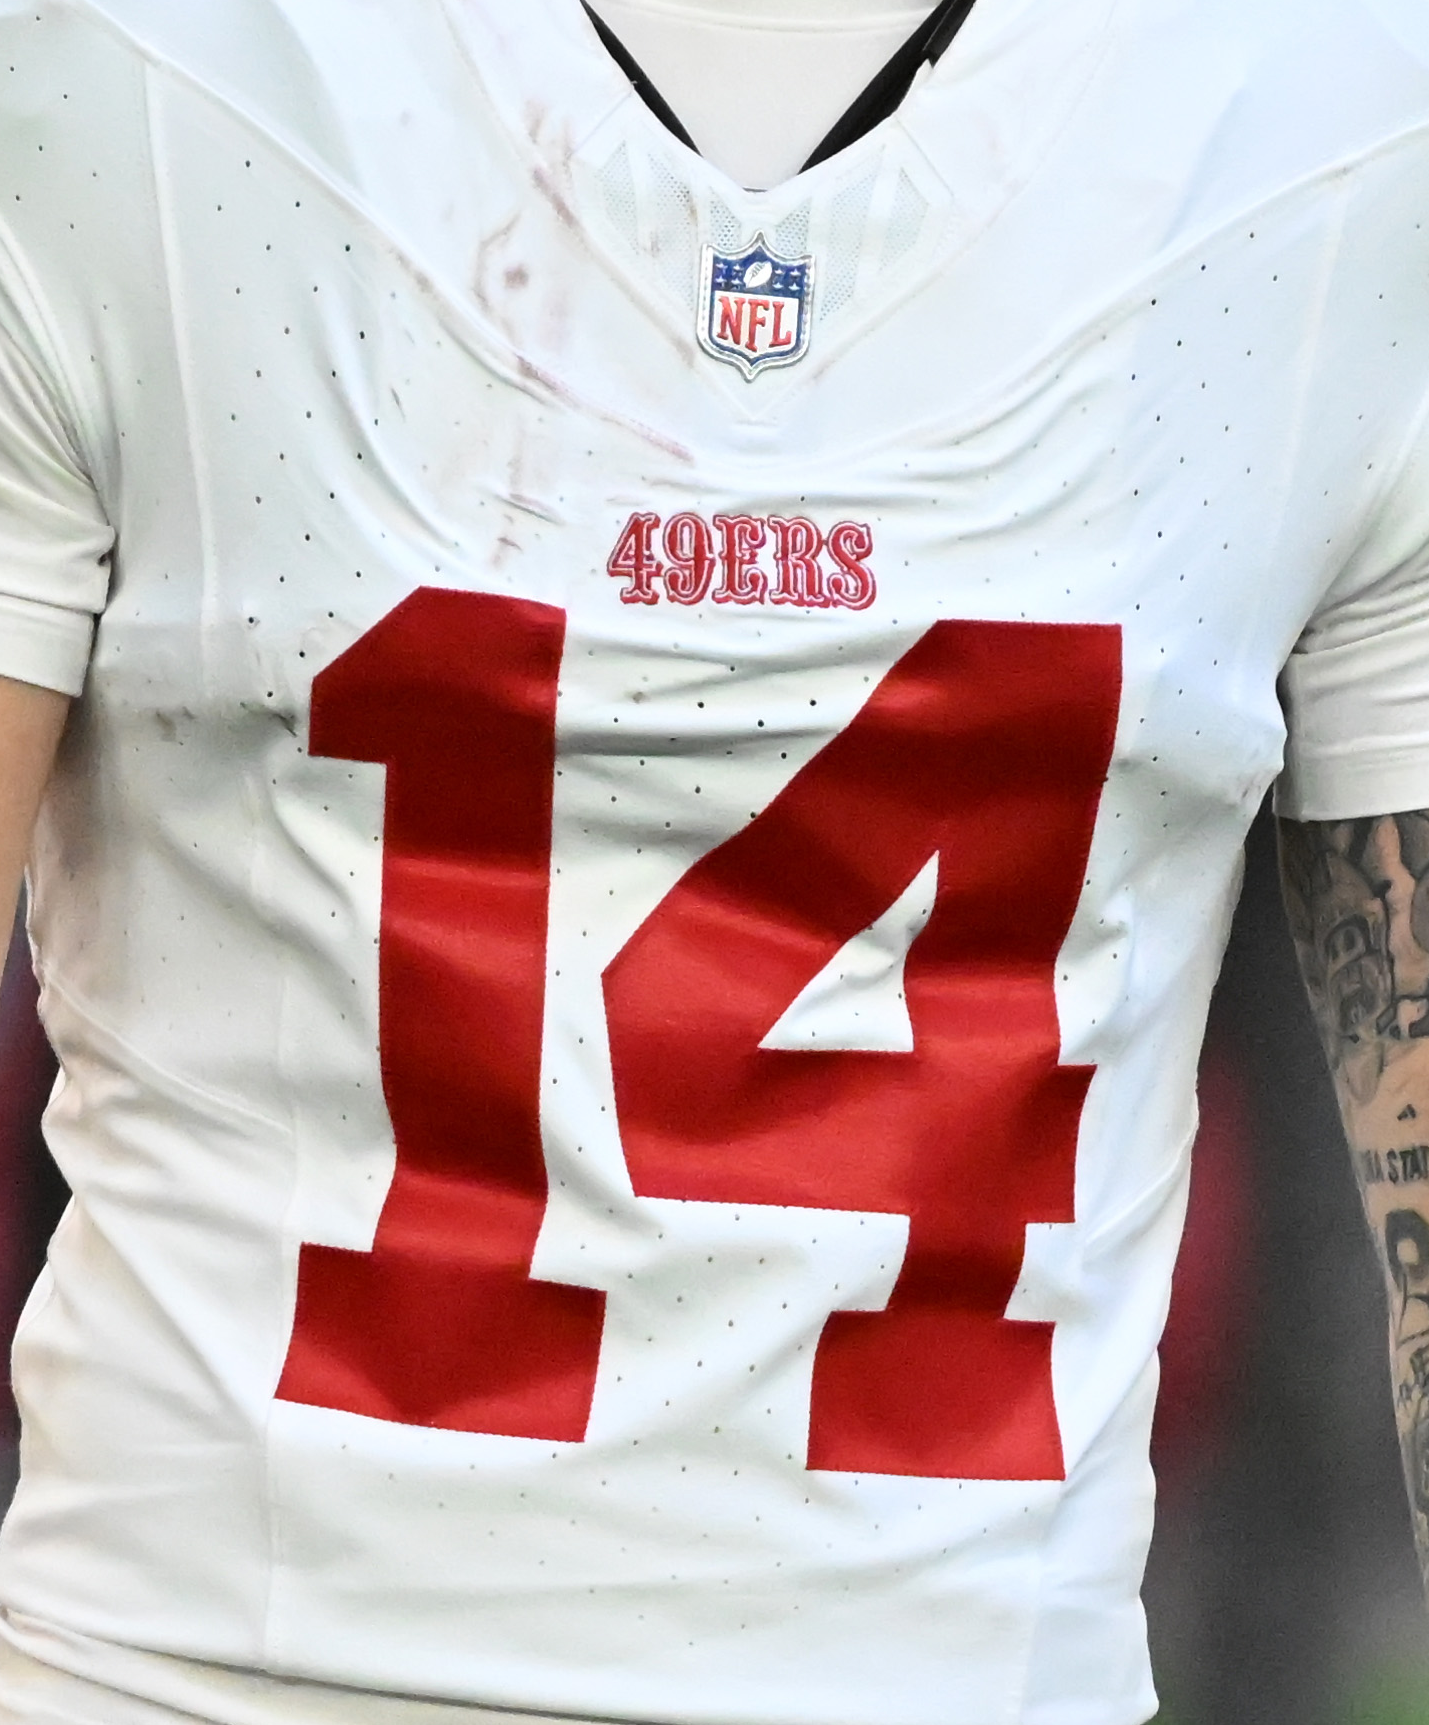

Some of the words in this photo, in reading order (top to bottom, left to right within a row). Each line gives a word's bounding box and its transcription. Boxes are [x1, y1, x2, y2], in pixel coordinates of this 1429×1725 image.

[717, 295, 793, 353] NFL
[606, 511, 877, 611] 49ERS
[273, 585, 1123, 1481] 14
